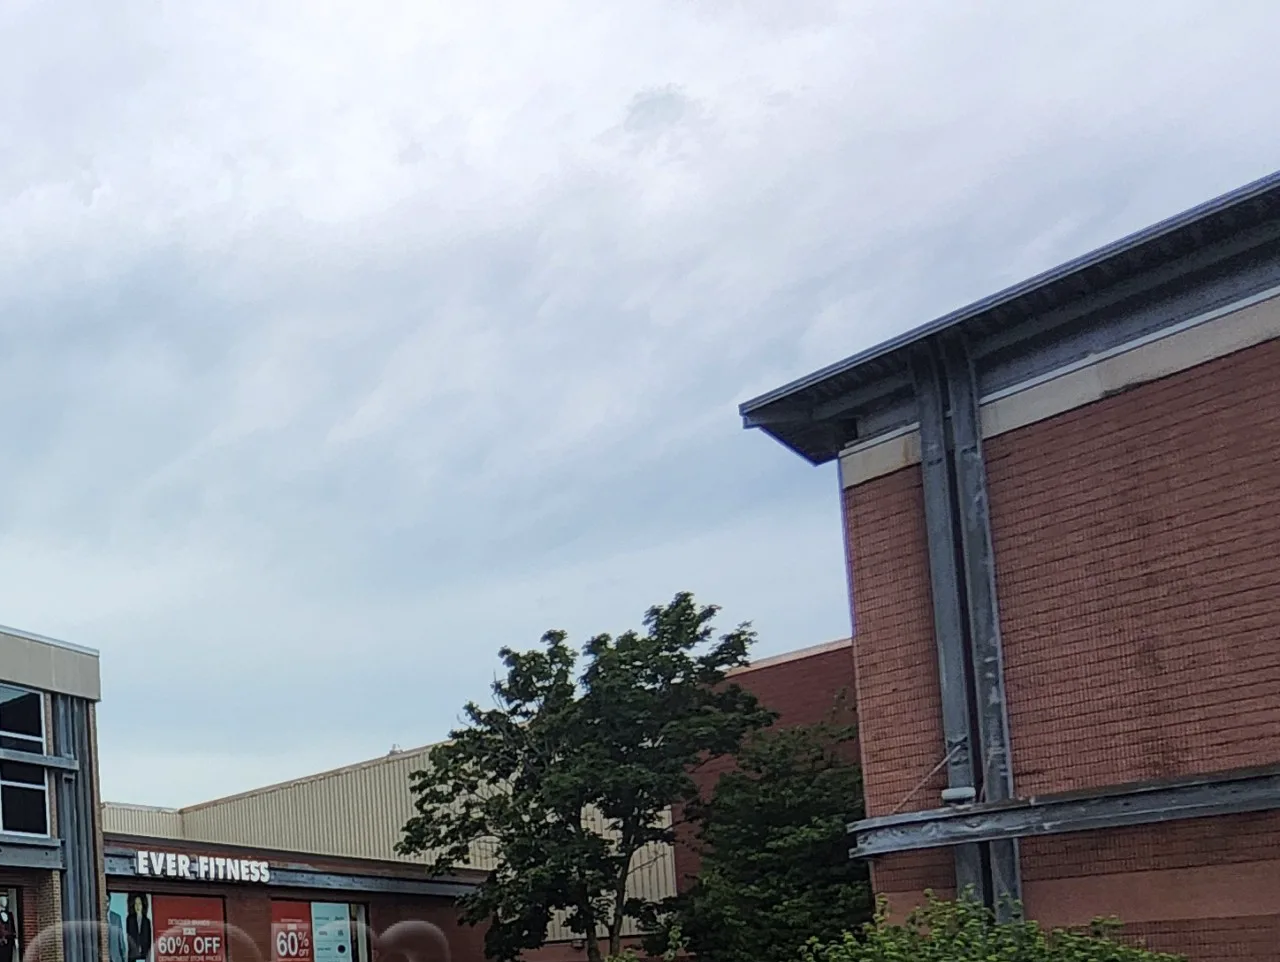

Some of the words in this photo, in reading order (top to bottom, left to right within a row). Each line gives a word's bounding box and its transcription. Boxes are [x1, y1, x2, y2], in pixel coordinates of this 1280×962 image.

[137, 850, 191, 878] EVER
[198, 855, 270, 883] FITNESS
[158, 936, 190, 954] 60%
[193, 936, 220, 954] OFF
[277, 931, 309, 956] 60%
